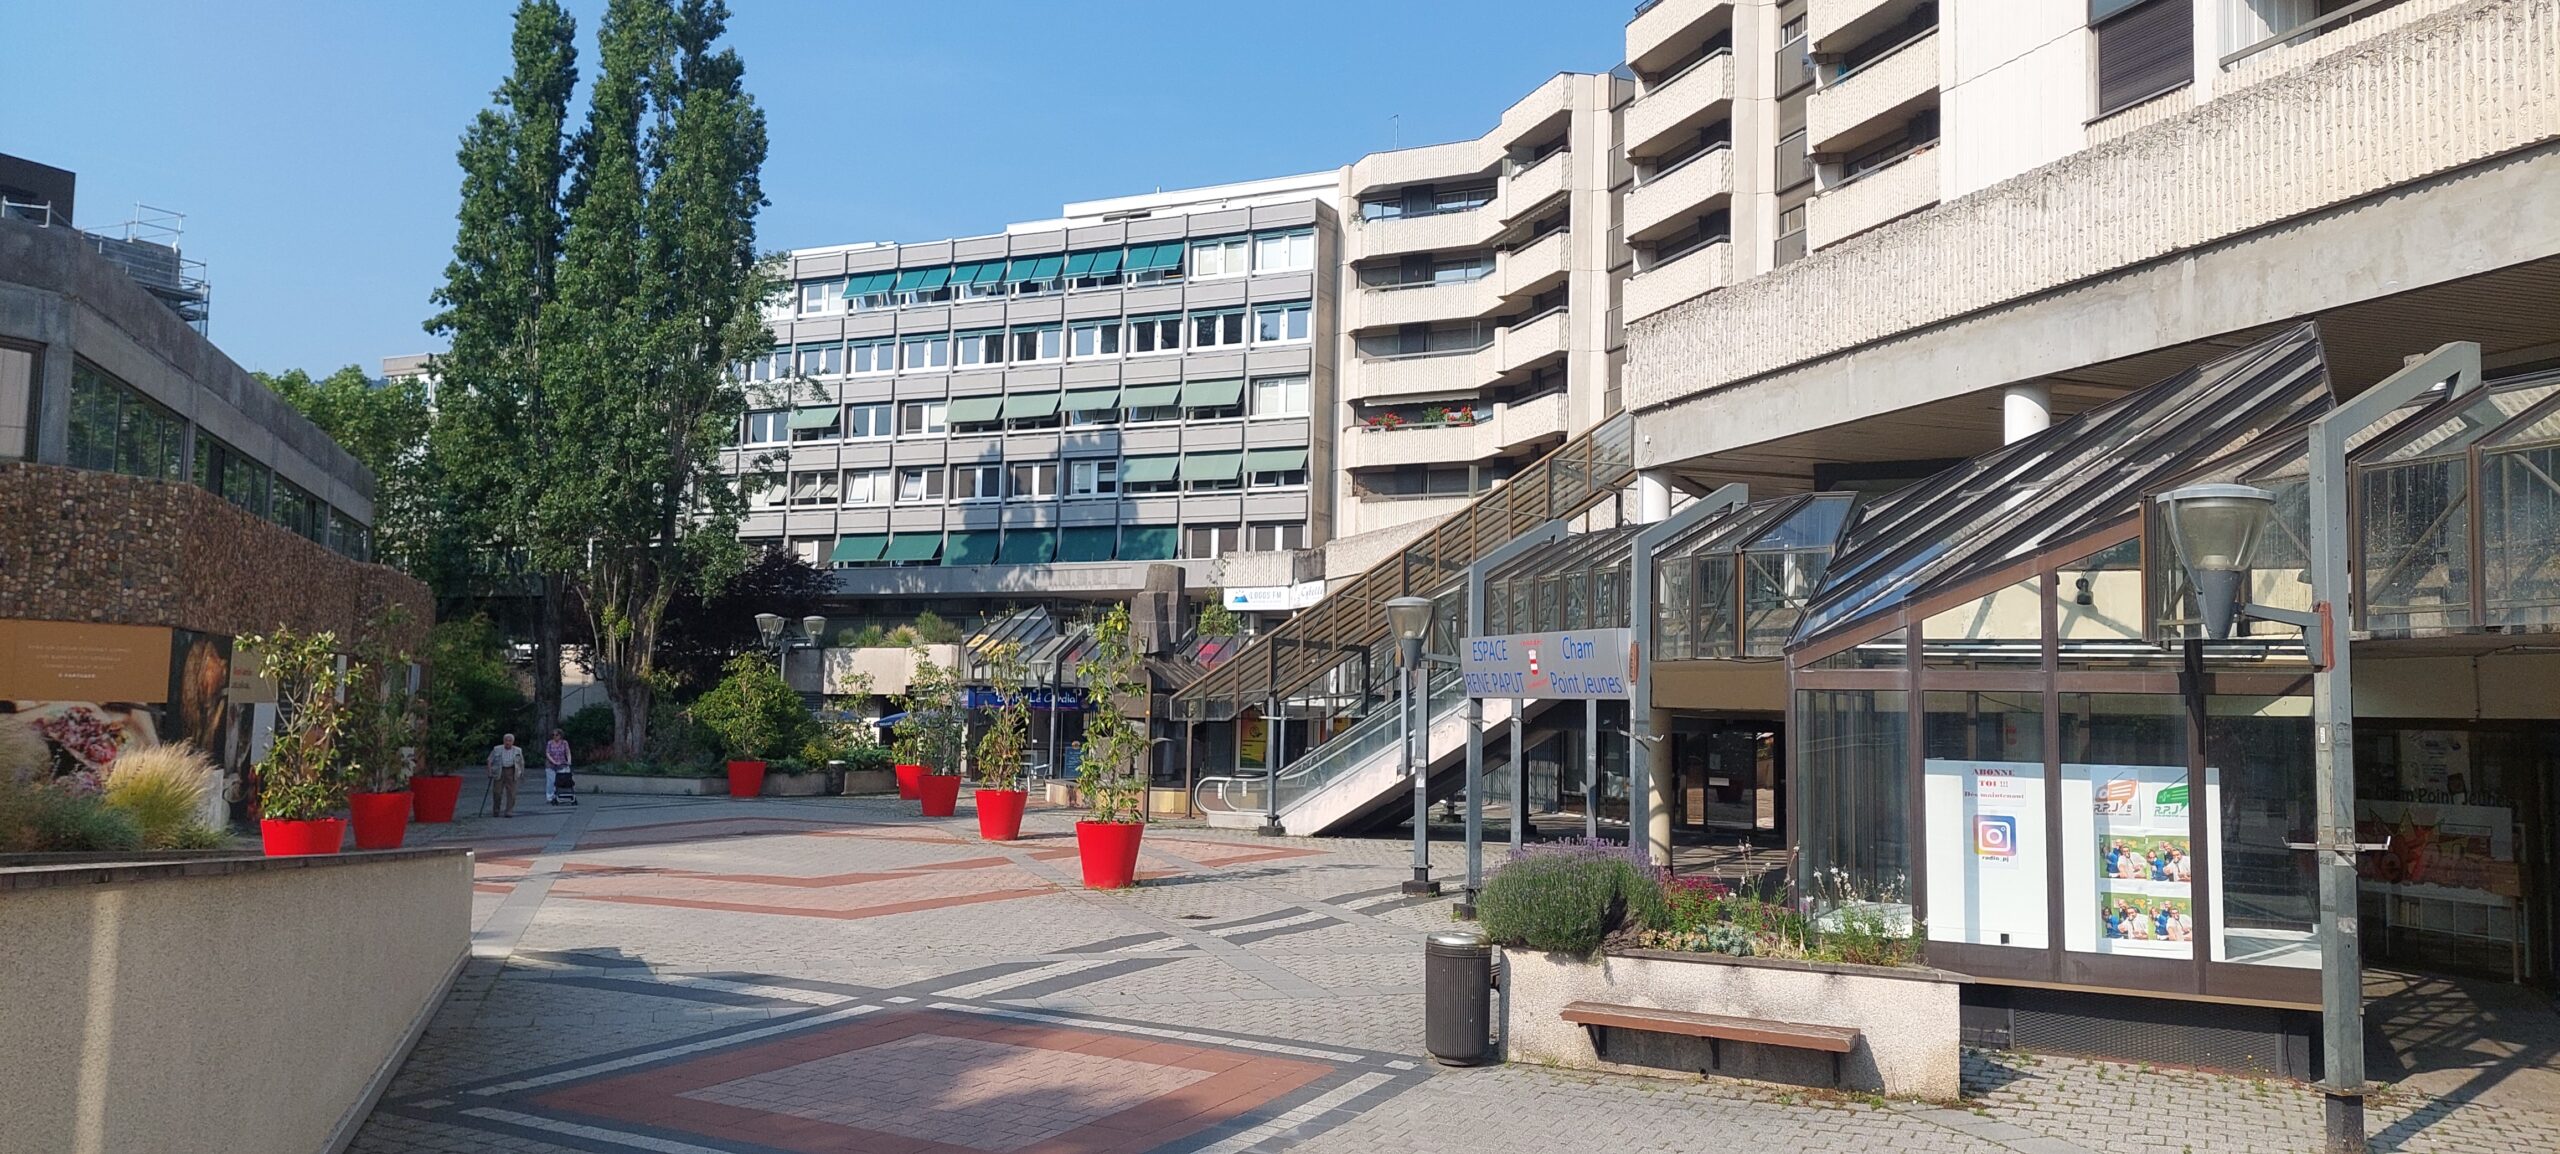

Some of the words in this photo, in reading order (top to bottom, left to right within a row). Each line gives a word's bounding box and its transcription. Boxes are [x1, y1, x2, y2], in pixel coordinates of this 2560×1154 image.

[1472, 639, 1508, 662] ESPACE
[1562, 635, 1596, 660] Cham'
[1465, 667, 1491, 694] RENÉ
[1493, 671, 1525, 694] PAPUT
[1550, 671, 1581, 694] Point
[1581, 671, 1623, 695] Jeunes
[1044, 692, 1078, 703] Crdial
[1972, 768, 2015, 777] ABONNE
